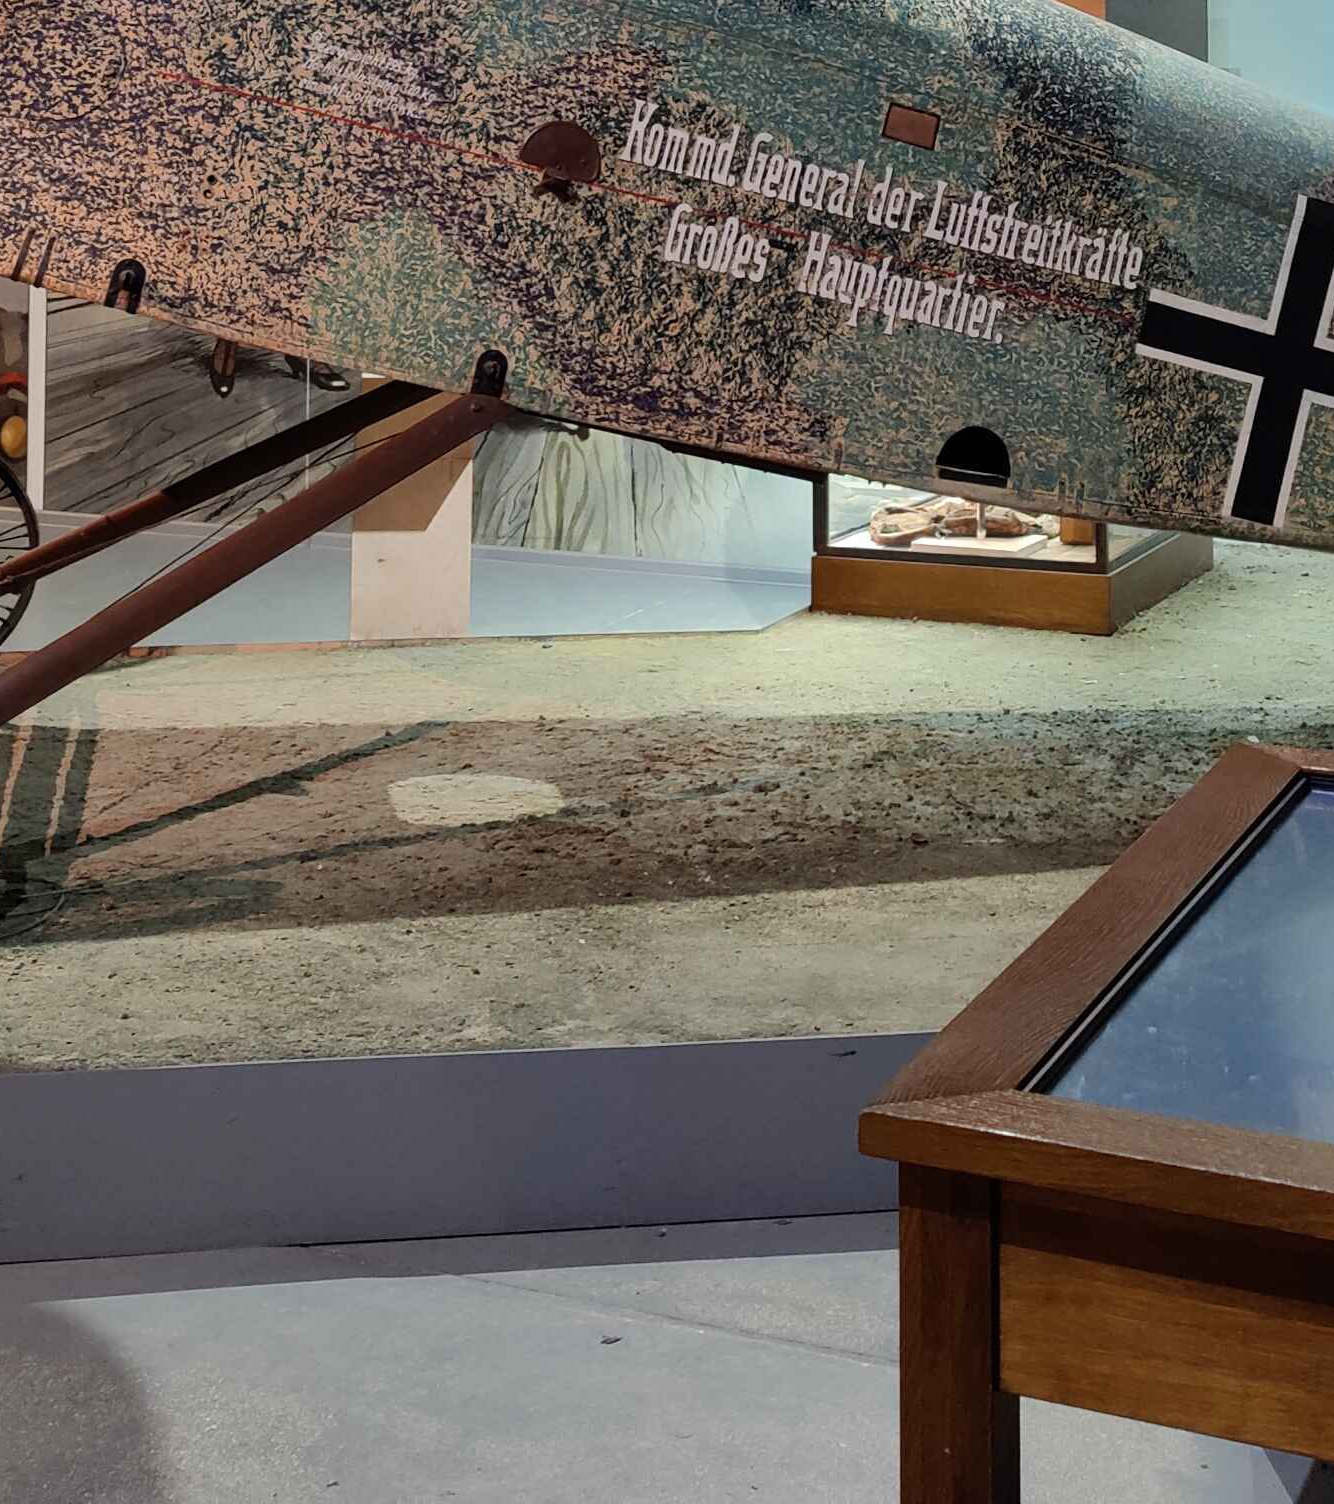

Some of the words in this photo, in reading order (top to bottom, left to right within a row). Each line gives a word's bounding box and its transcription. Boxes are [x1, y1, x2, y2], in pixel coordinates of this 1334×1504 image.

[620, 98, 739, 187] Kommd.
[742, 132, 868, 219] General
[866, 164, 925, 234] der
[922, 179, 1144, 290] Luftstreitkräfte
[666, 203, 770, 283] Großes
[797, 230, 1006, 345] Hauptquartier.
